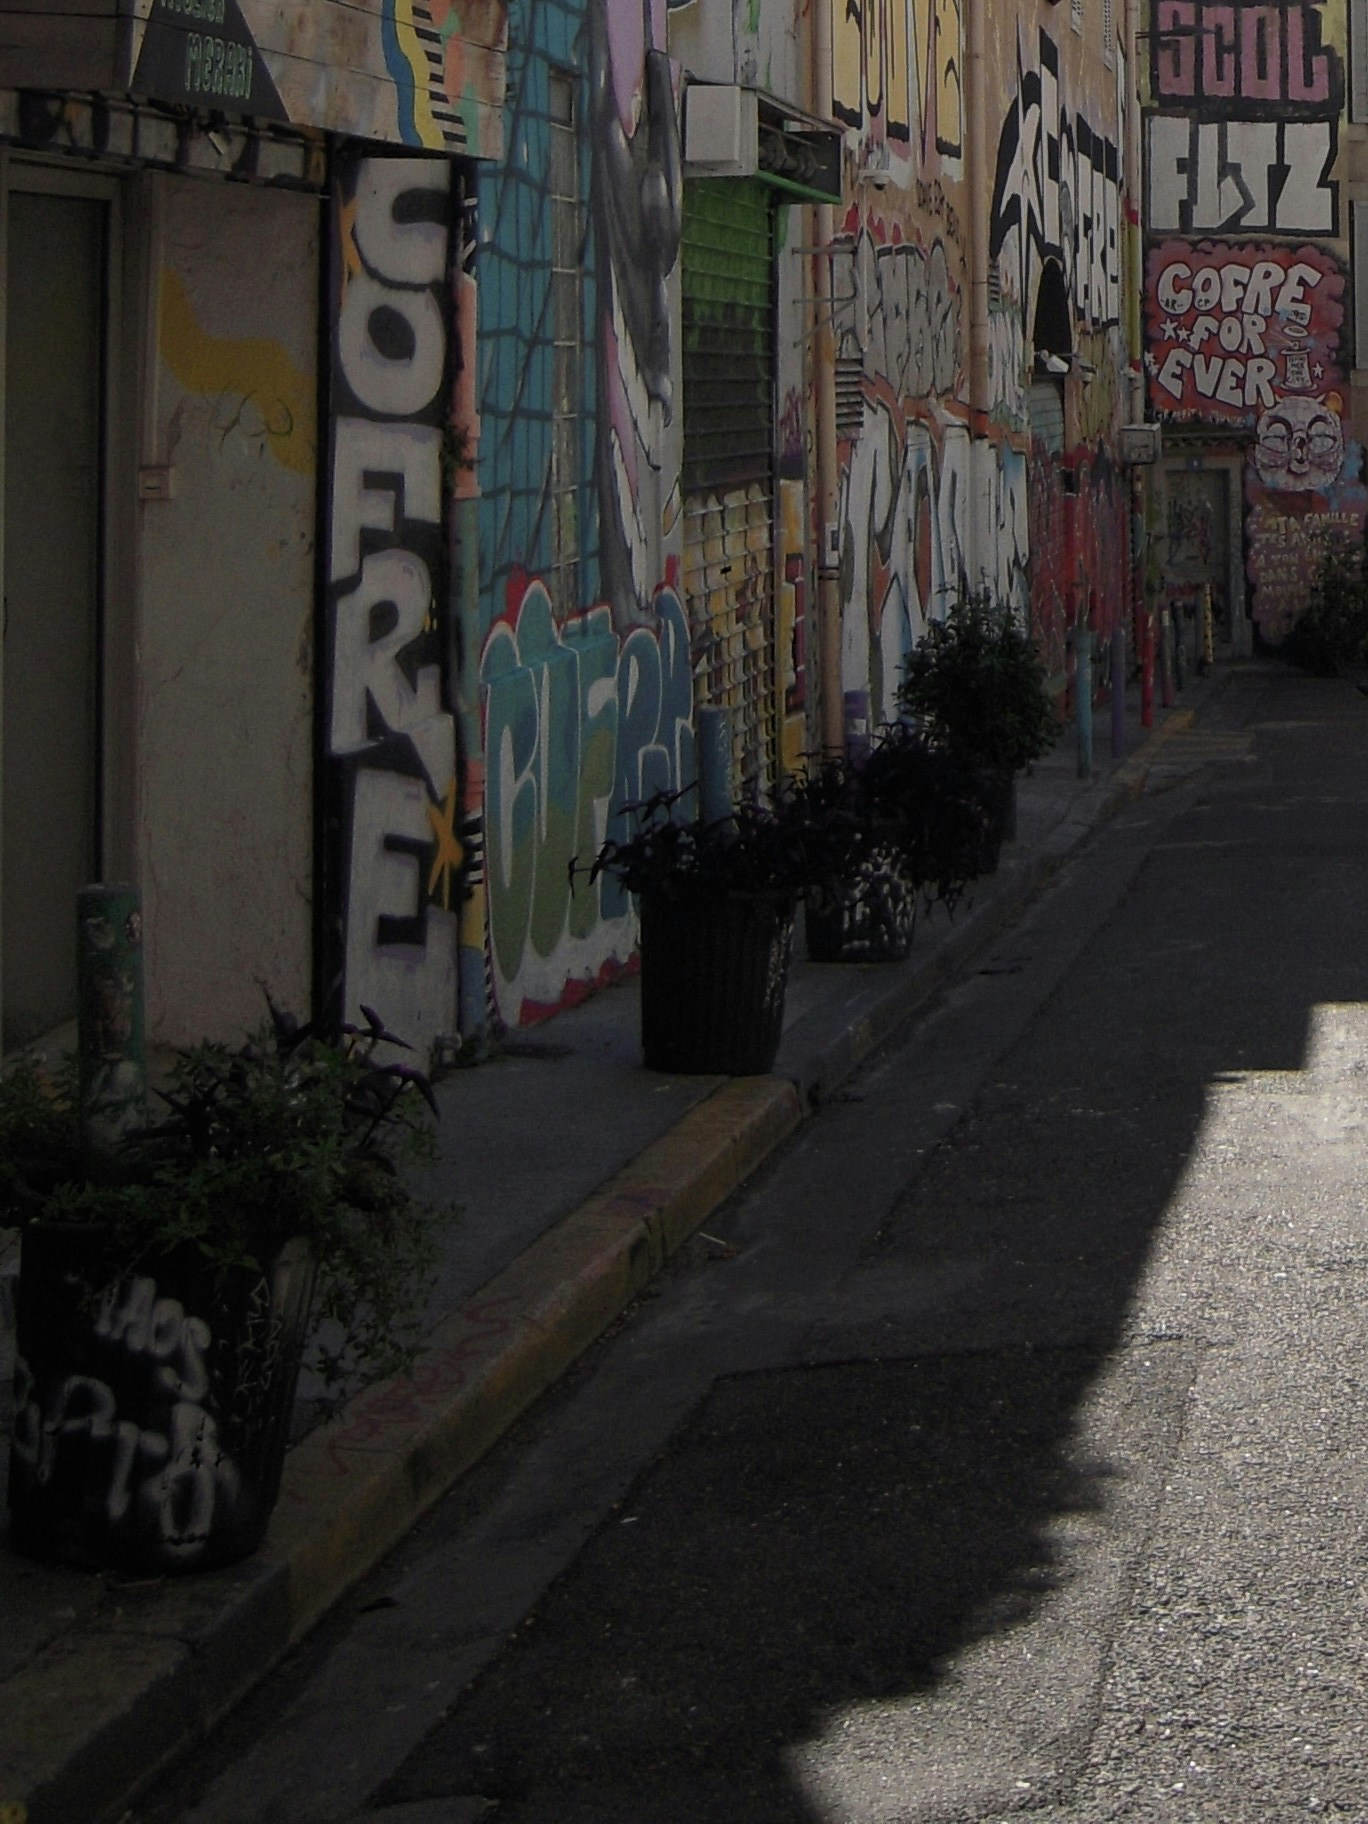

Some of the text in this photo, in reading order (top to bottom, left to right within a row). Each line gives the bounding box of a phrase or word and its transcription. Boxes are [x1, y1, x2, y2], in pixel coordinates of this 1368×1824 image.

[1157, 261, 1322, 326] COFRE
[1188, 314, 1267, 355] FOR
[1157, 347, 1276, 408] EVER
[330, 158, 457, 1074] COFRE
